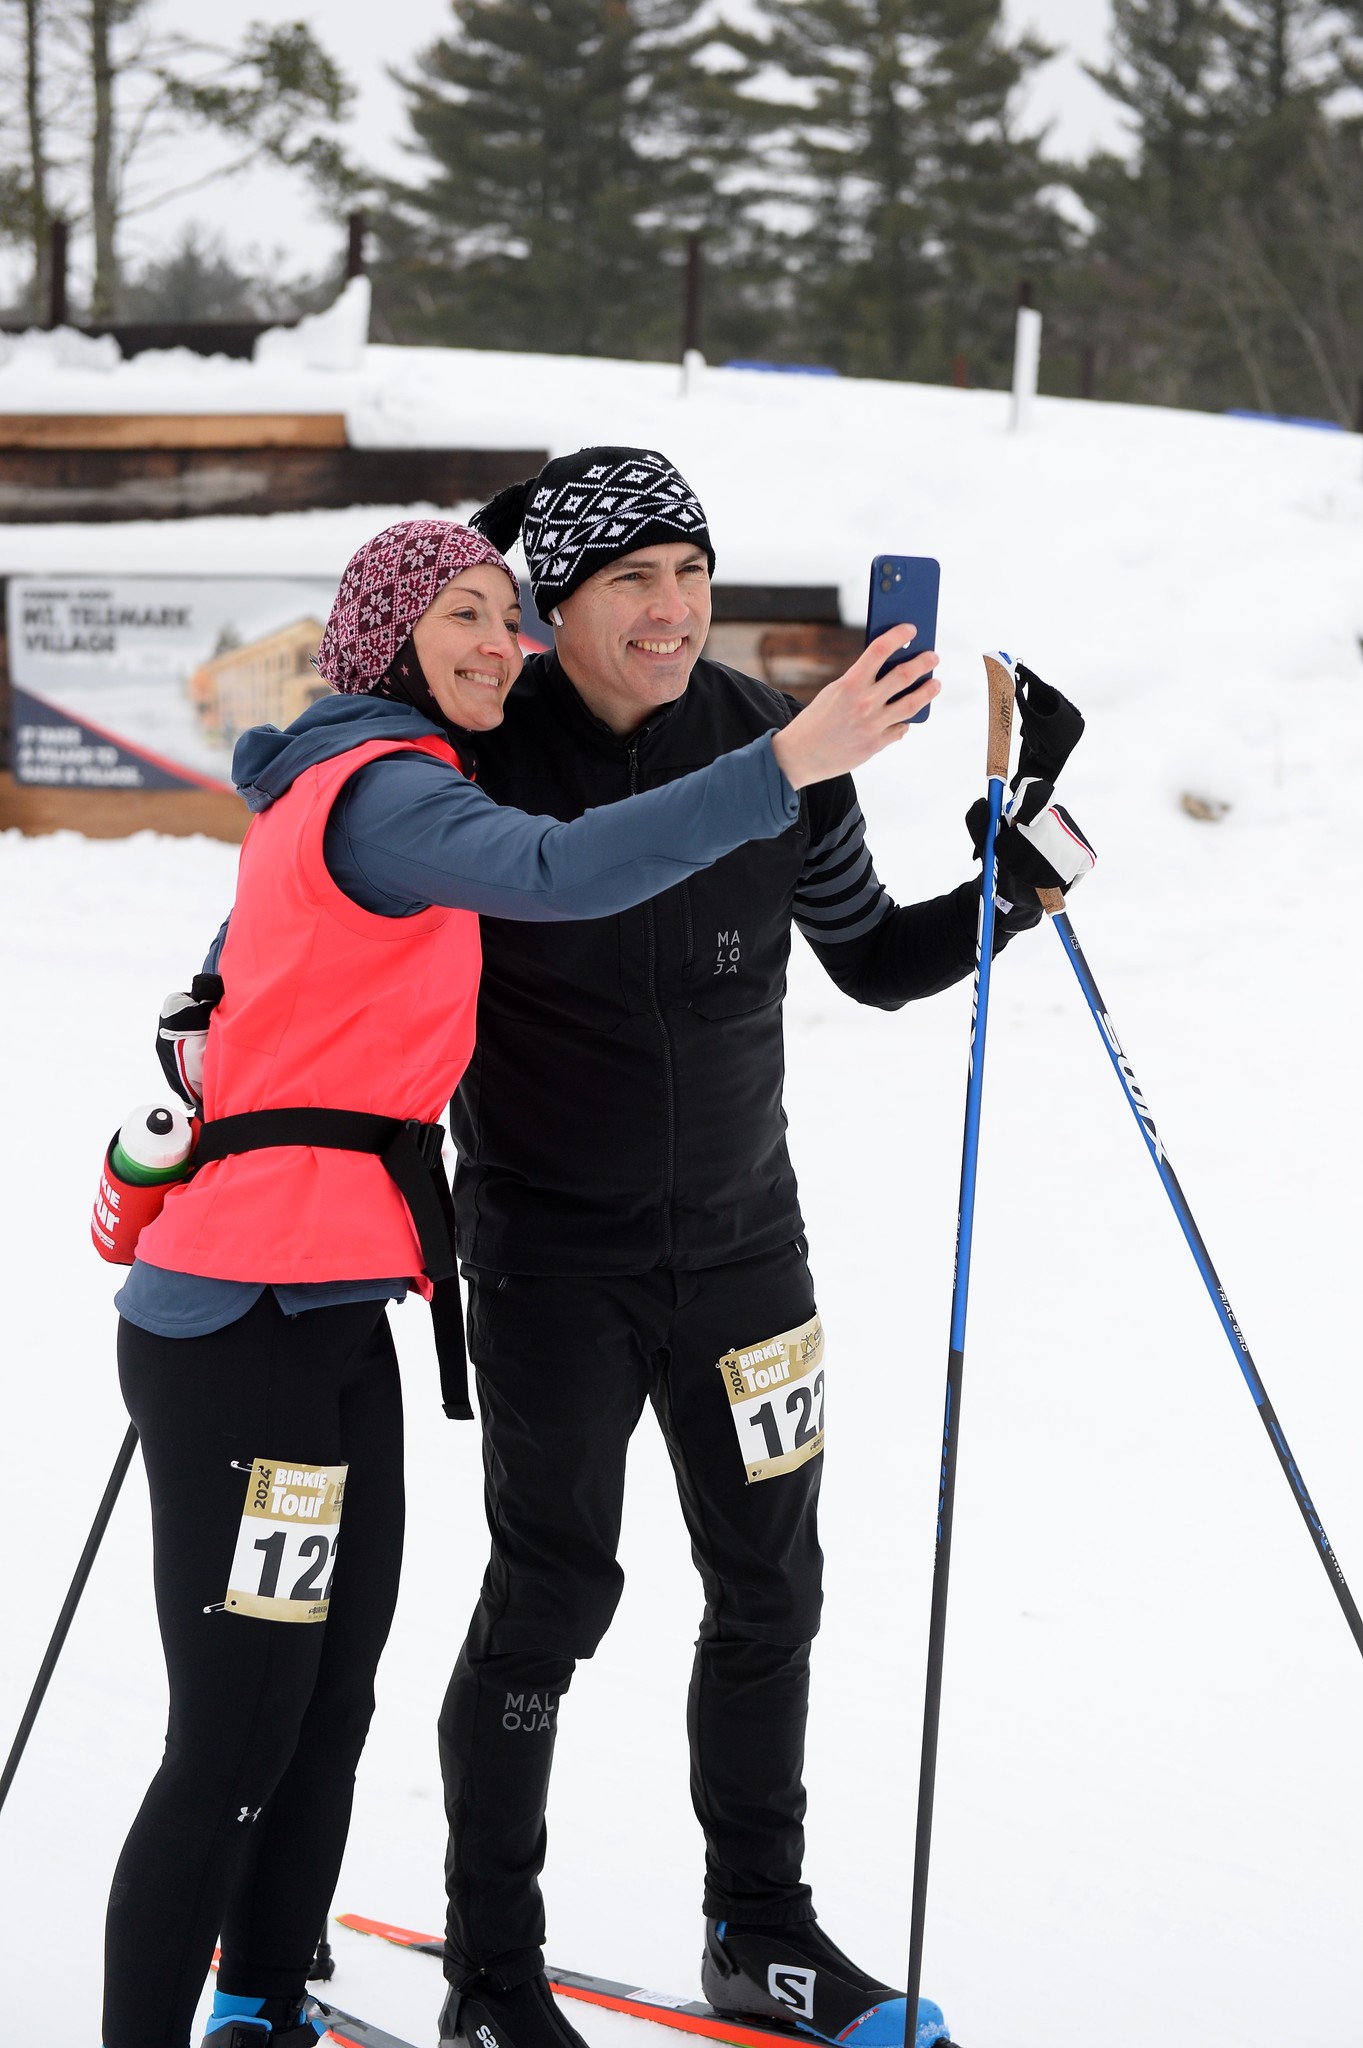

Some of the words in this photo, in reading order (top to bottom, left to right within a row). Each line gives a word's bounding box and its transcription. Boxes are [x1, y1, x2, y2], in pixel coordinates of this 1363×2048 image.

[69, 607, 189, 628] TELEMARK
[25, 633, 115, 652] VILLAGE
[100, 1173, 120, 1210] KIE
[1217, 1285, 1236, 1320] TRIAC
[738, 1340, 787, 1369] BIRKIE
[727, 1360, 745, 1396] 2024
[742, 1359, 790, 1393] Tour
[254, 1466, 272, 1509] 2024
[274, 1468, 328, 1490] BIRKIE
[271, 1486, 325, 1518] Tour
[254, 1530, 339, 1601] 12
[504, 1692, 555, 1712] MAL
[502, 1712, 551, 1732] OJA
